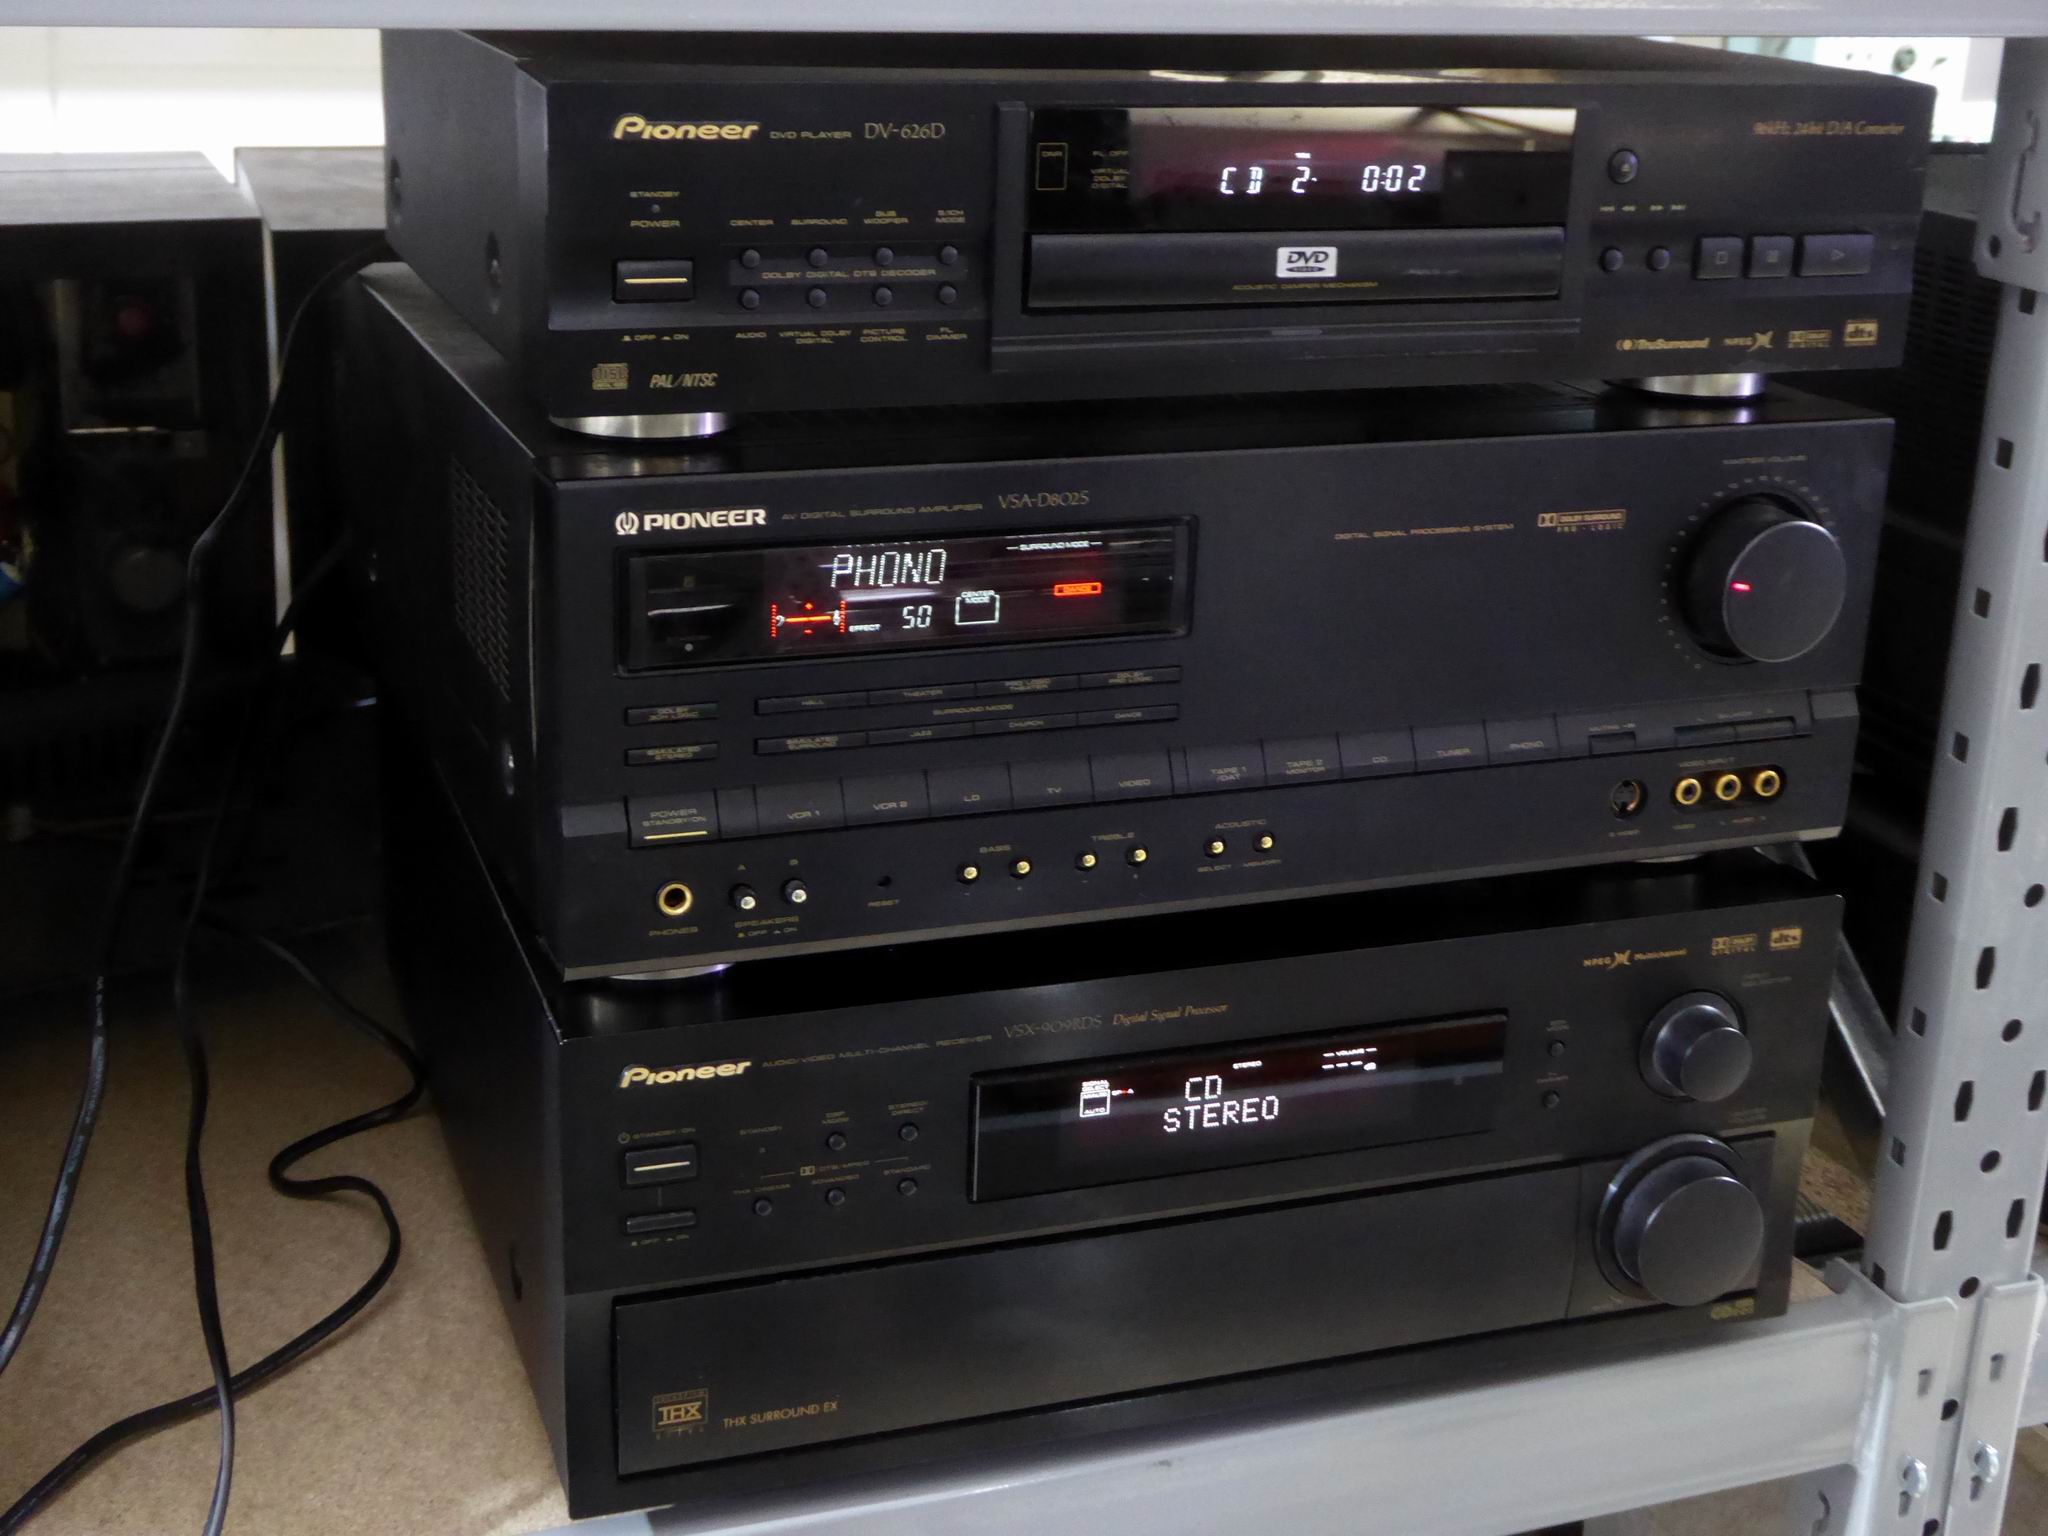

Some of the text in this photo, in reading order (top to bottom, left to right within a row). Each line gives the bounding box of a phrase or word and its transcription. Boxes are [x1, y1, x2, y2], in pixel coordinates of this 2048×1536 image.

[613, 115, 946, 140] Pioneer DVD PLAYER DV-626D
[1361, 165, 1426, 192] 0:02
[630, 219, 681, 228] POWER
[729, 218, 775, 227] CENTER
[790, 218, 849, 226] SURROUND
[1287, 251, 1329, 264] DVD
[761, 270, 801, 279] DOLBY
[806, 270, 849, 278] DIGITAL
[881, 268, 937, 277] DECODER
[735, 331, 768, 339] AUDIO
[649, 372, 719, 389] PAL/NTSC
[643, 508, 767, 531] PIONEER
[801, 510, 846, 519] DIGITAL
[851, 506, 915, 517] SURROUND
[919, 504, 983, 513] AMPLIFIER
[831, 549, 947, 588] PHONO
[849, 605, 932, 633] EFFECT 50
[1509, 740, 1544, 750] PHONO
[1436, 748, 1472, 758] TUNER
[1286, 760, 1314, 769] TAPE
[1210, 766, 1240, 776] TAPE
[1118, 778, 1151, 788] VIDEO
[963, 794, 980, 802] LD
[873, 802, 897, 810] VCR
[650, 808, 698, 818] POWER
[787, 811, 812, 820] VCR
[1215, 819, 1267, 830] ACOUSTIC
[1091, 832, 1135, 842] TREBLE
[979, 844, 1011, 854] BASS
[619, 1060, 752, 1089] Pioneer
[1112, 1010, 1149, 1027] Digital
[1150, 1006, 1182, 1023] Signal
[1184, 1003, 1229, 1018] Processor
[1185, 1075, 1222, 1101] CD
[1084, 1107, 1106, 1115] AUTO
[1164, 1095, 1279, 1133] STEREO
[658, 1401, 702, 1425] THX
[723, 1401, 839, 1429] THX SURROUND EX
